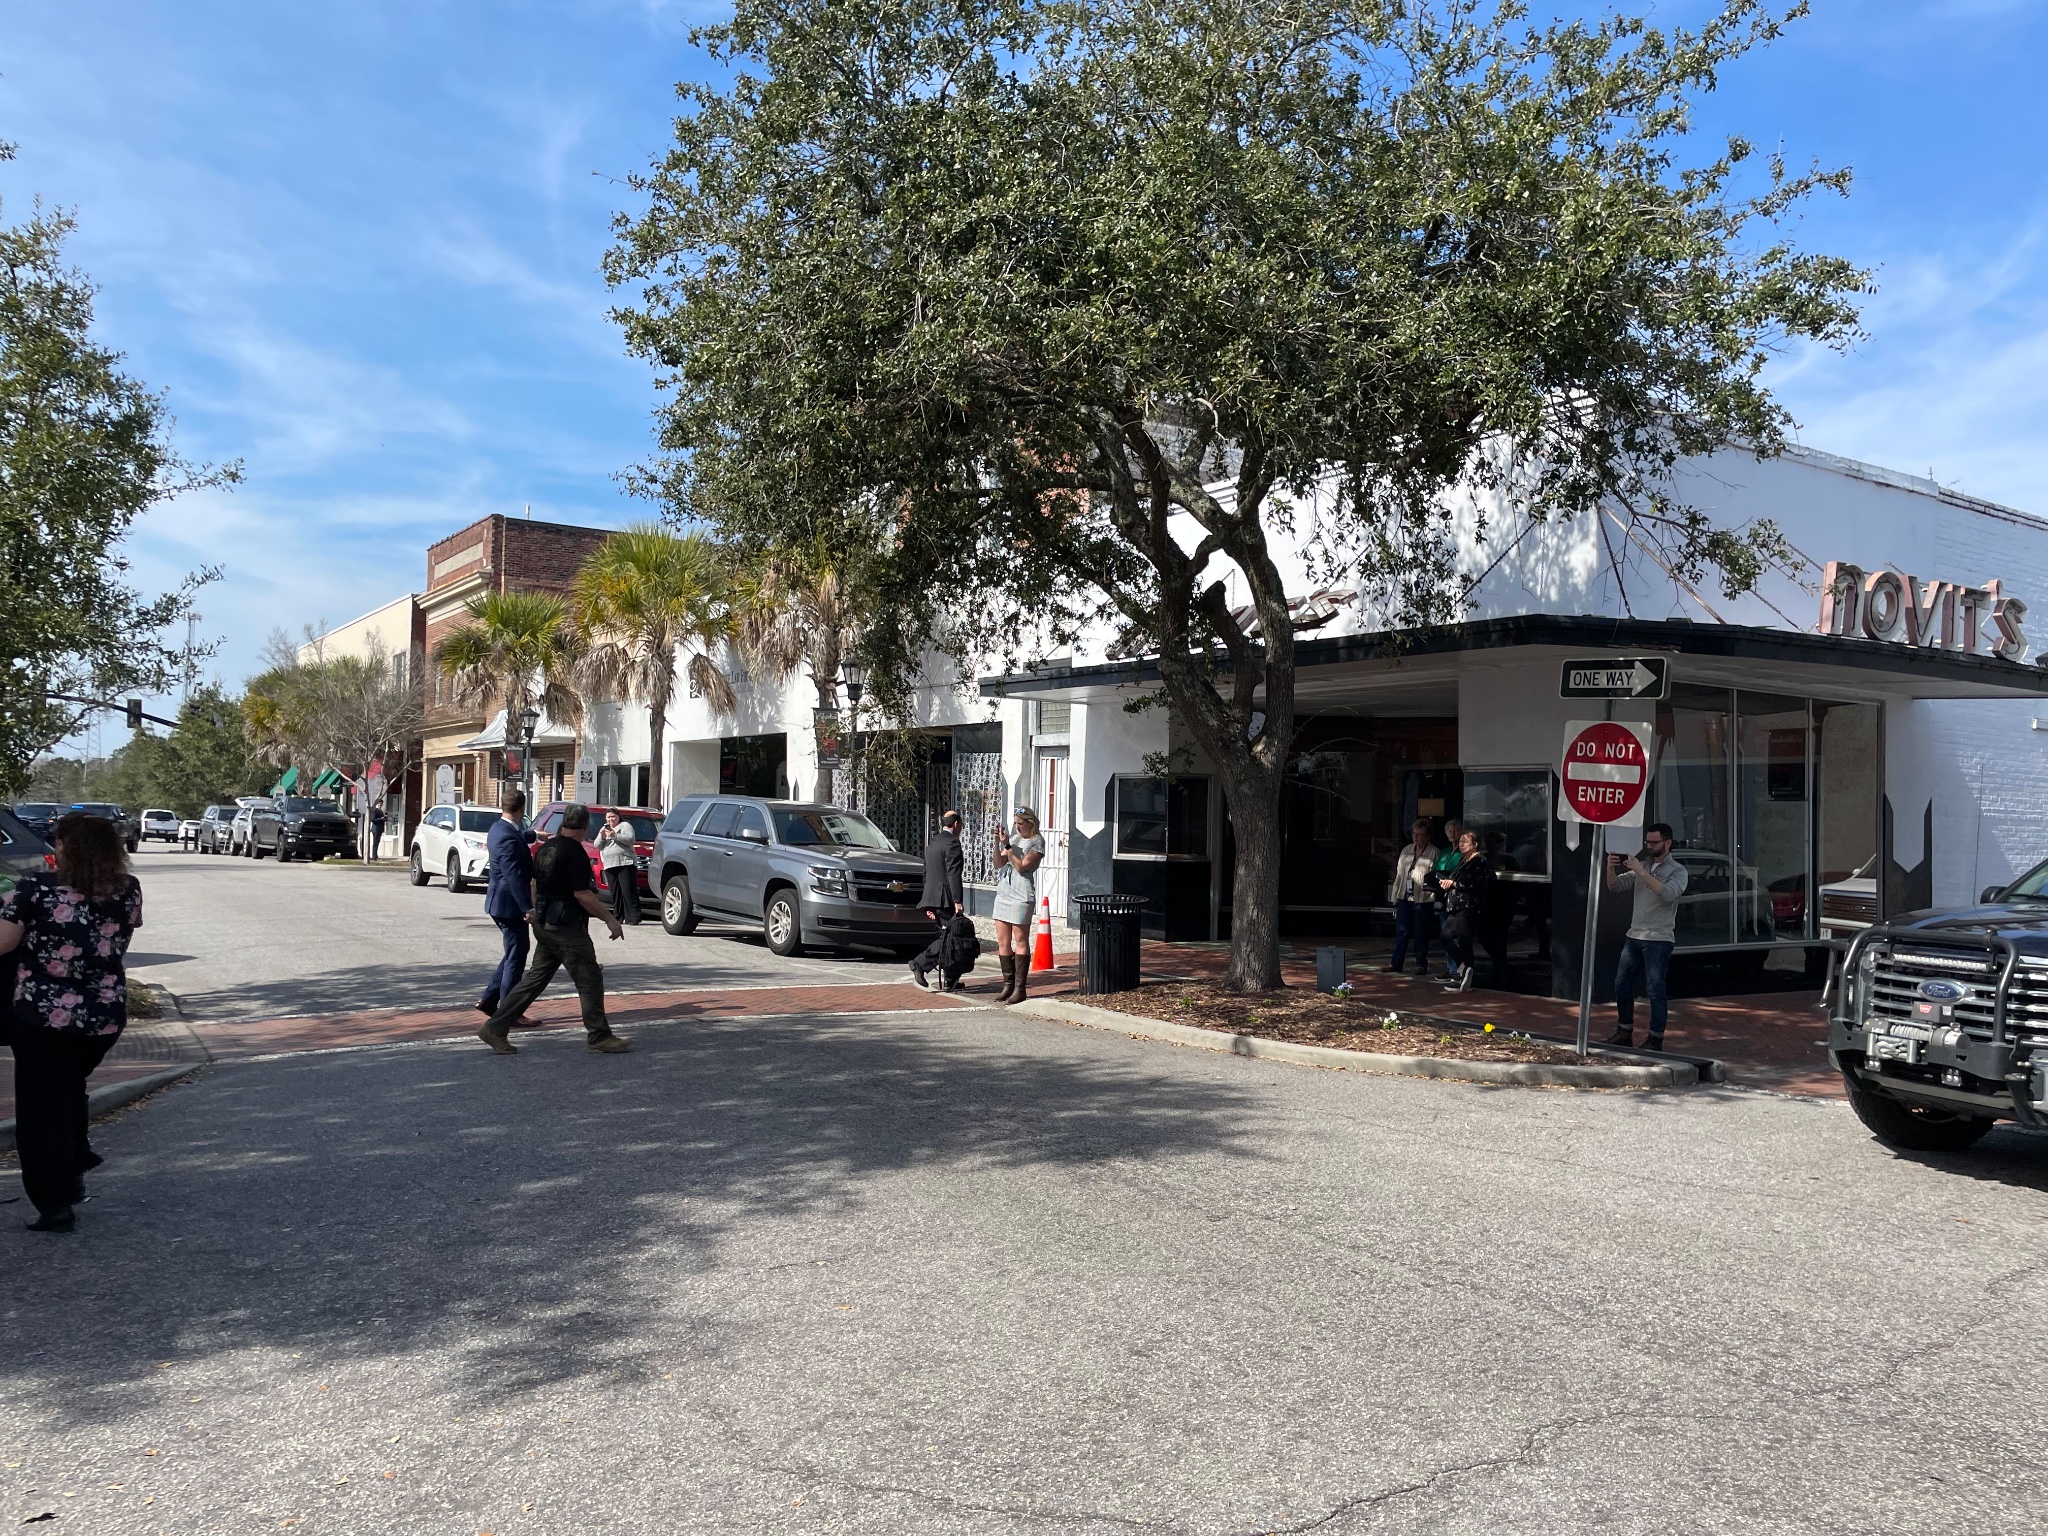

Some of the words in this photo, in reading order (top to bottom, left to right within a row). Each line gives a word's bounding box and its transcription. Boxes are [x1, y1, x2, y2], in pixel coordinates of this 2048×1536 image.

[1573, 671, 1600, 687] ONE
[1606, 671, 1634, 687] WAY
[1576, 741, 1596, 757] DO
[1605, 742, 1636, 760] NOT
[1577, 785, 1625, 805] ENTER
[1926, 984, 1951, 998] Ford
